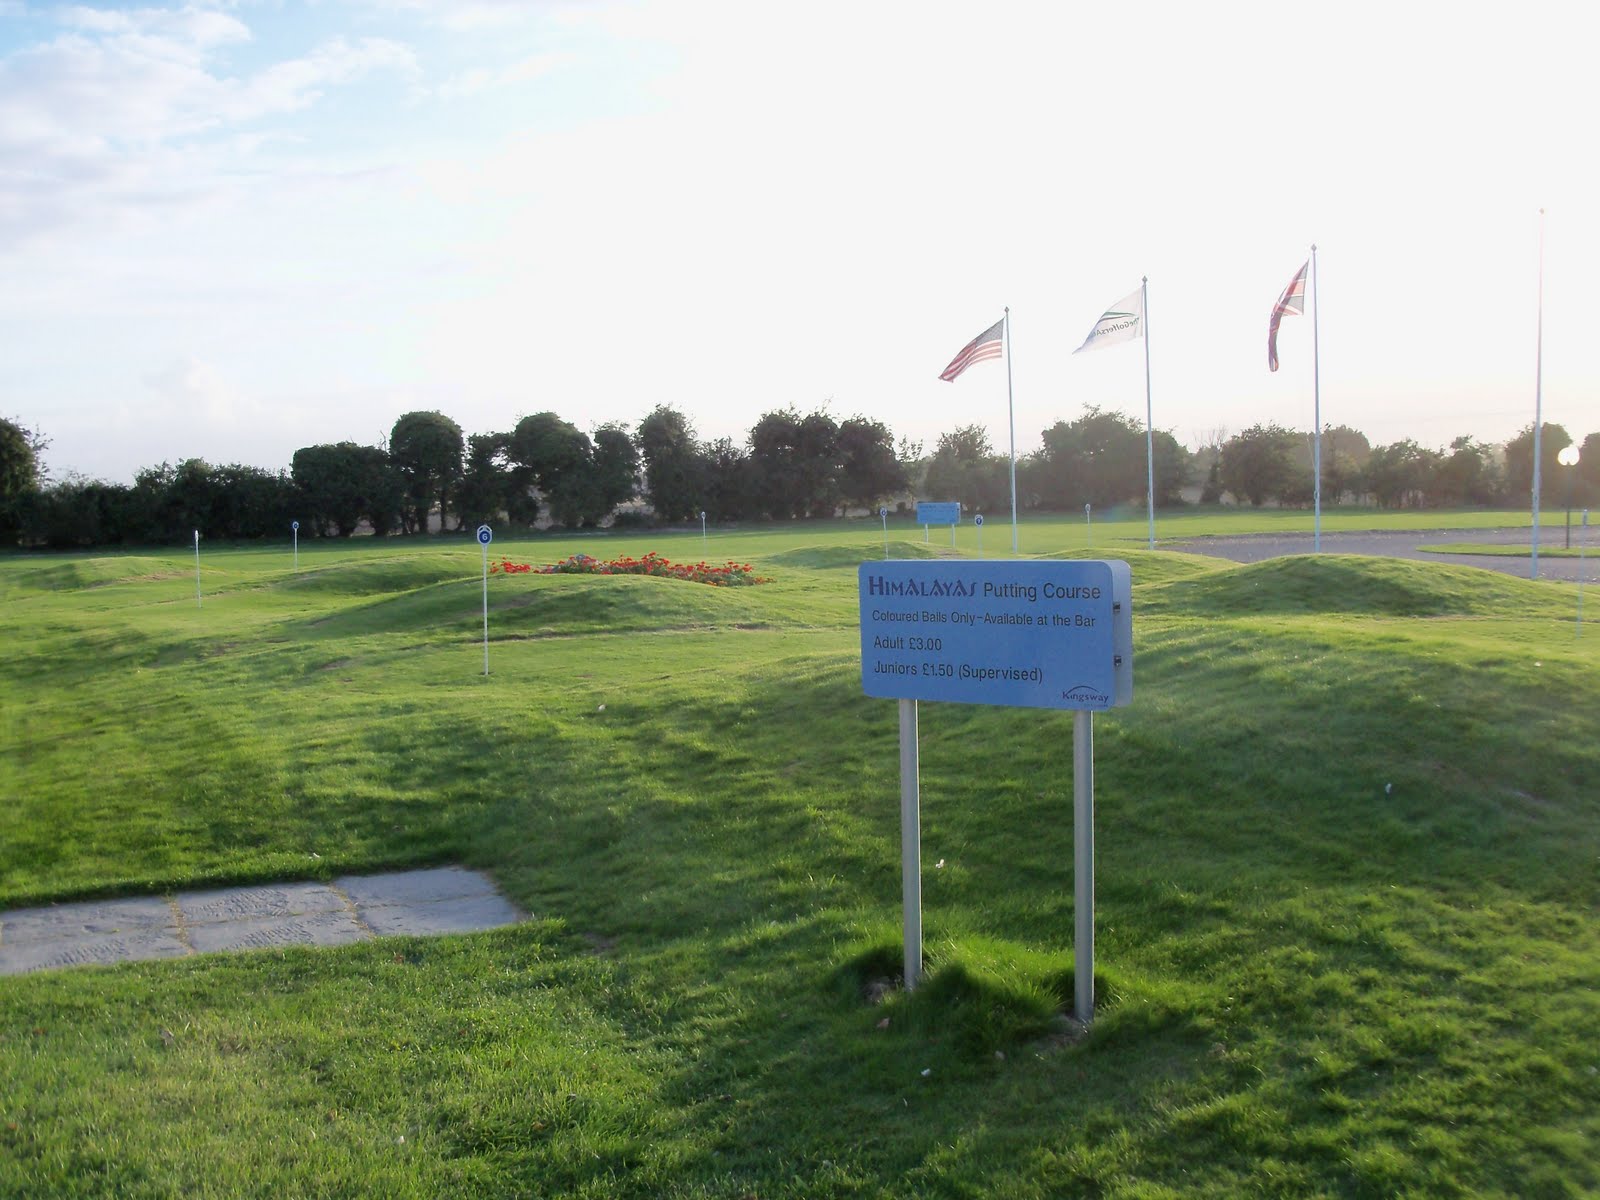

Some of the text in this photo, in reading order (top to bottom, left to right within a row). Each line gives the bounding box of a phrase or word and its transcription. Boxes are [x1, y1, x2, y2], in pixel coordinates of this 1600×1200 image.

[482, 533, 488, 541] 6
[984, 582, 1037, 602] Putting
[1043, 582, 1101, 600] Course
[872, 609, 919, 623] Coloured
[922, 611, 947, 623] Balls
[1037, 614, 1048, 626] at
[1052, 614, 1071, 627] the
[1075, 615, 1095, 627] Bar
[874, 635, 942, 651] Adult £3.00
[874, 661, 1043, 684] Juniors £1.50 (Supervised)
[1062, 691, 1109, 703] Kingsway
